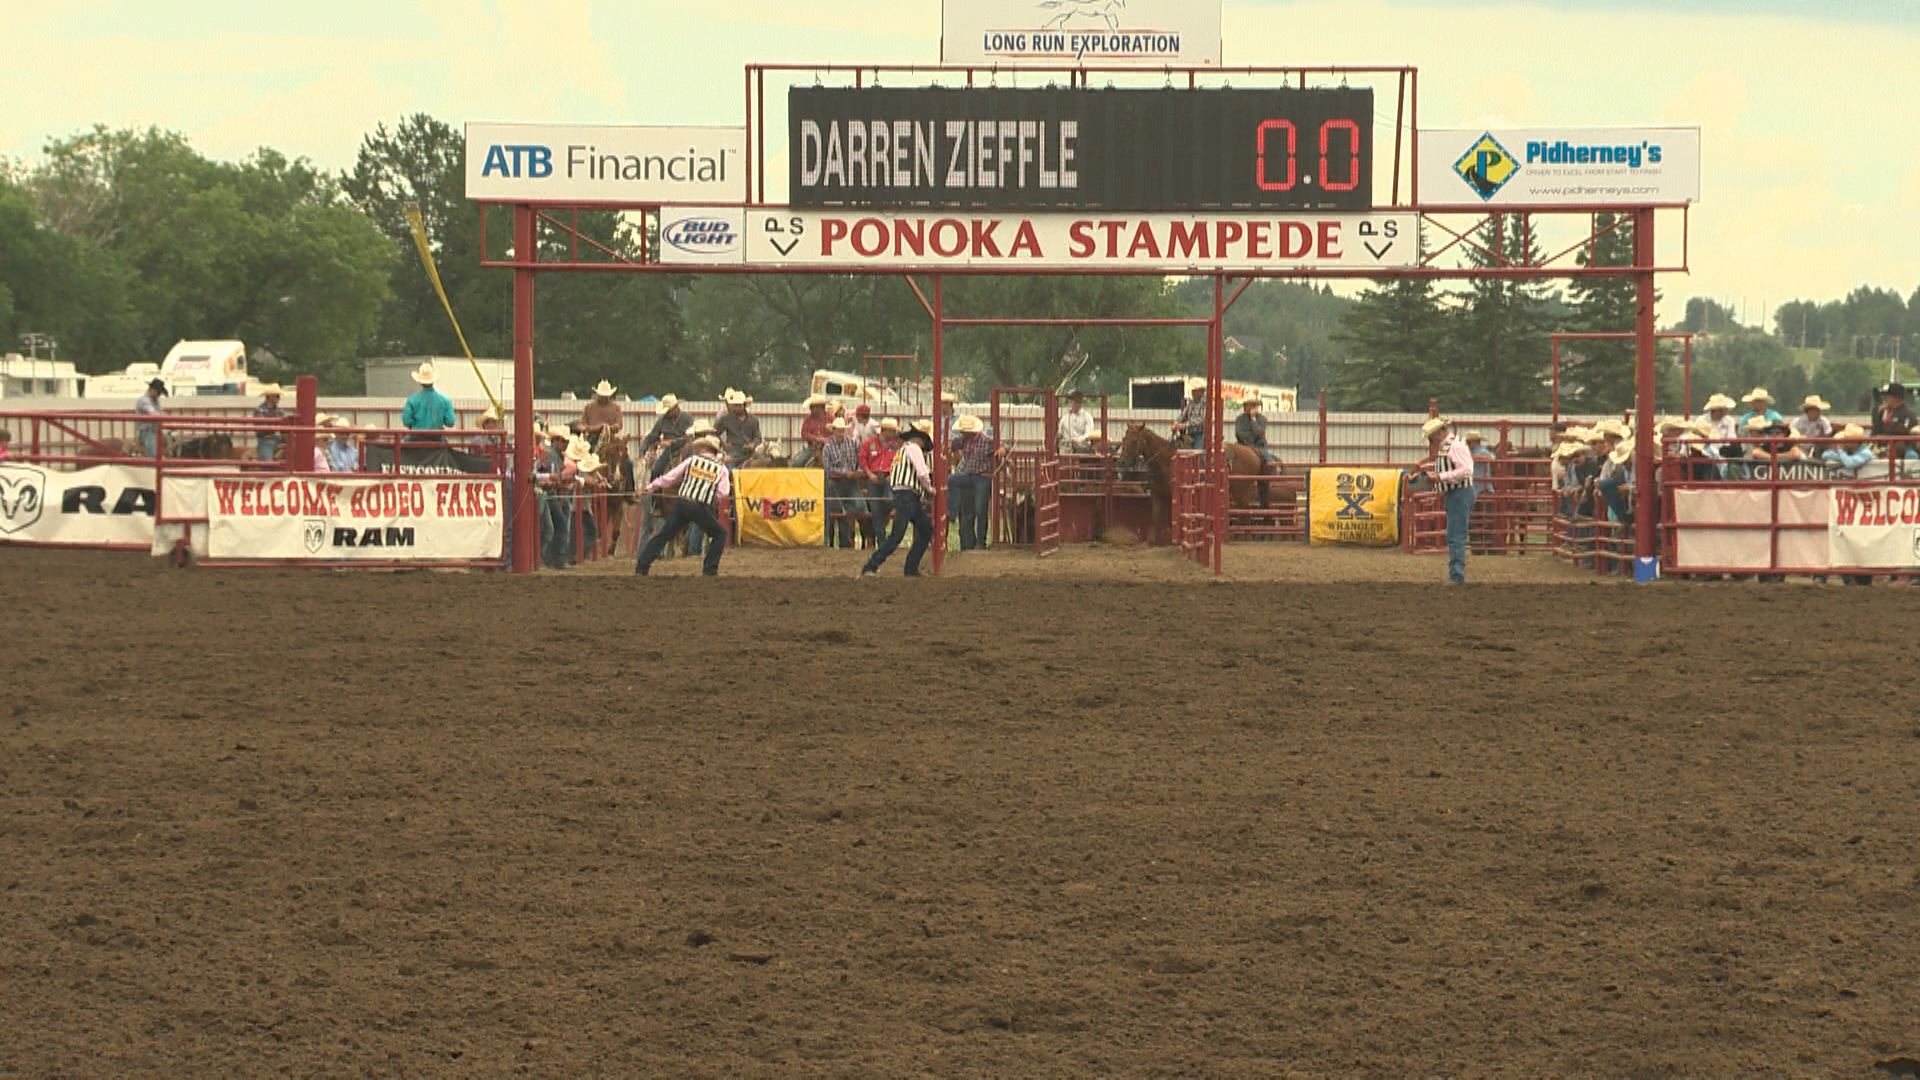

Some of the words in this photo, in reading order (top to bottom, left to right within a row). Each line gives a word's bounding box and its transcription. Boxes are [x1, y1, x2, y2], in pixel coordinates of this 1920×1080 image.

[984, 33, 1026, 51] LONG
[1032, 34, 1065, 52] RUN
[1071, 34, 1180, 60] EXPLORATION
[482, 144, 553, 178] ATB
[568, 145, 726, 182] Financial
[801, 120, 935, 187] DARREN
[945, 120, 1078, 188] ZIEFFLE
[1526, 140, 1662, 168] Pidherney's
[1529, 184, 1660, 196] www.pidherneys.com
[672, 234, 738, 245] LIGHT
[682, 222, 730, 232] BUD
[820, 218, 1043, 259] PONOKA
[1069, 219, 1344, 260] STAMPEDE
[1336, 473, 1374, 492] 20
[214, 480, 342, 516] WELCOME
[351, 483, 424, 517] RODEO
[436, 483, 497, 517] FANS
[1336, 493, 1374, 519] X
[1836, 489, 1920, 526] WELCO
[332, 527, 415, 546] RAM
